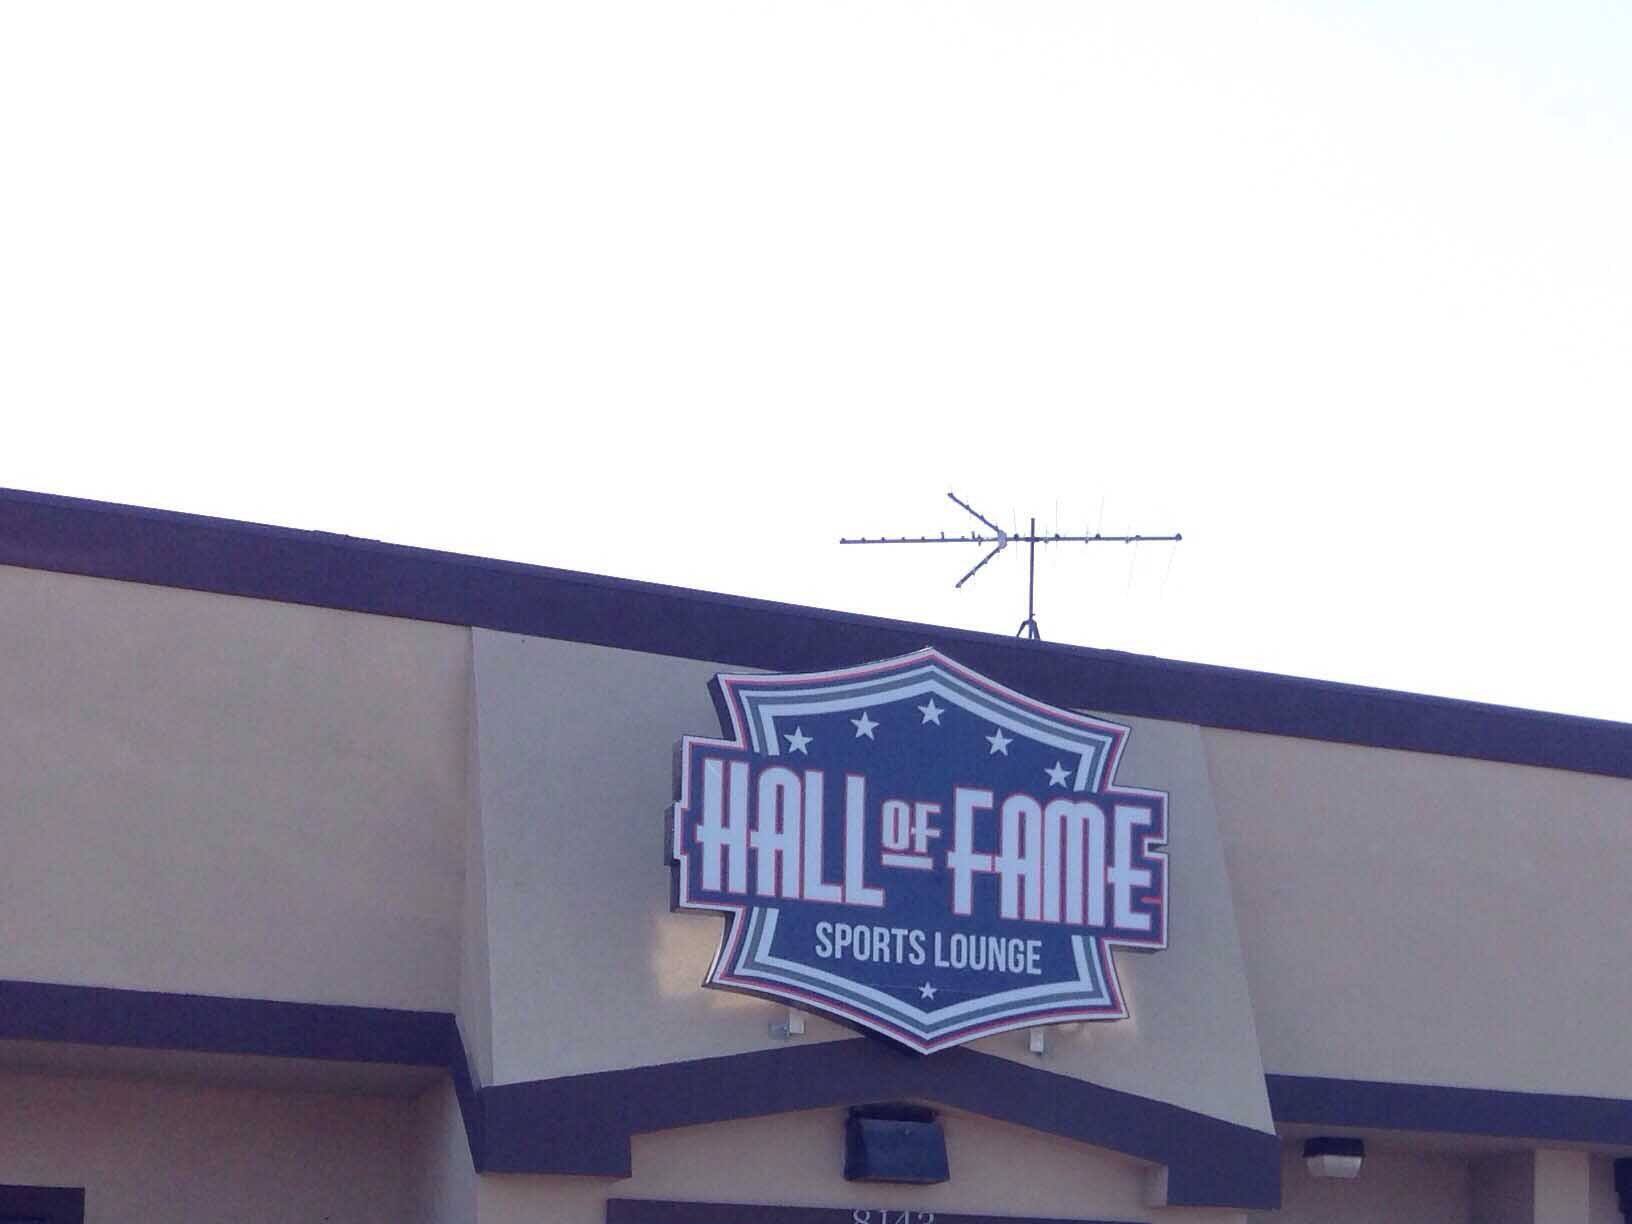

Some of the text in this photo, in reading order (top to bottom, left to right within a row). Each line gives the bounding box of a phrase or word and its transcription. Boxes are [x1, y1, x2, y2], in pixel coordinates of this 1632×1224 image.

[696, 758, 1152, 930] HALL OF FAME
[815, 921, 1043, 976] SPORTS LOUNGE
